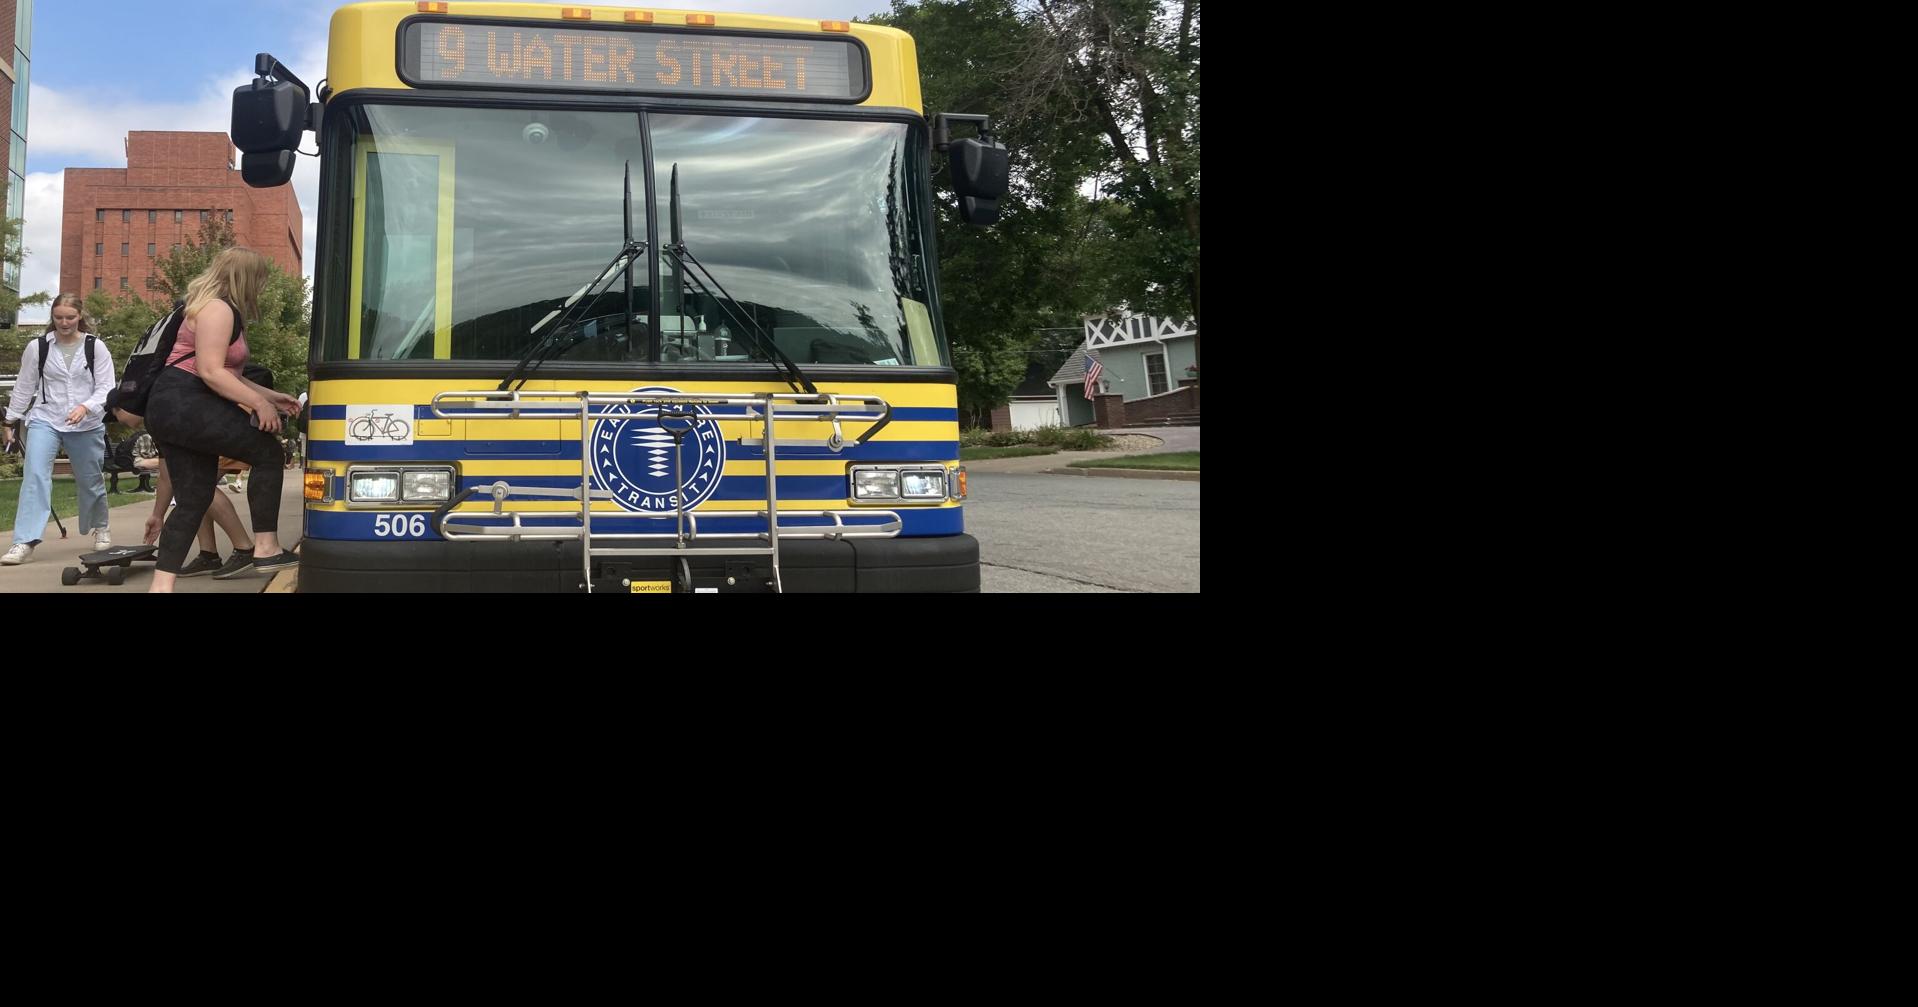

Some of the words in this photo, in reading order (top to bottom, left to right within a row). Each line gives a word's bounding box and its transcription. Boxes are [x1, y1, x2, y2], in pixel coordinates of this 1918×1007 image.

[438, 26, 465, 80] 9
[487, 31, 636, 84] WATER
[656, 39, 814, 90] STREET
[616, 482, 699, 510] TRANSIT
[374, 514, 426, 537] 506
[632, 583, 670, 592] sportworks
